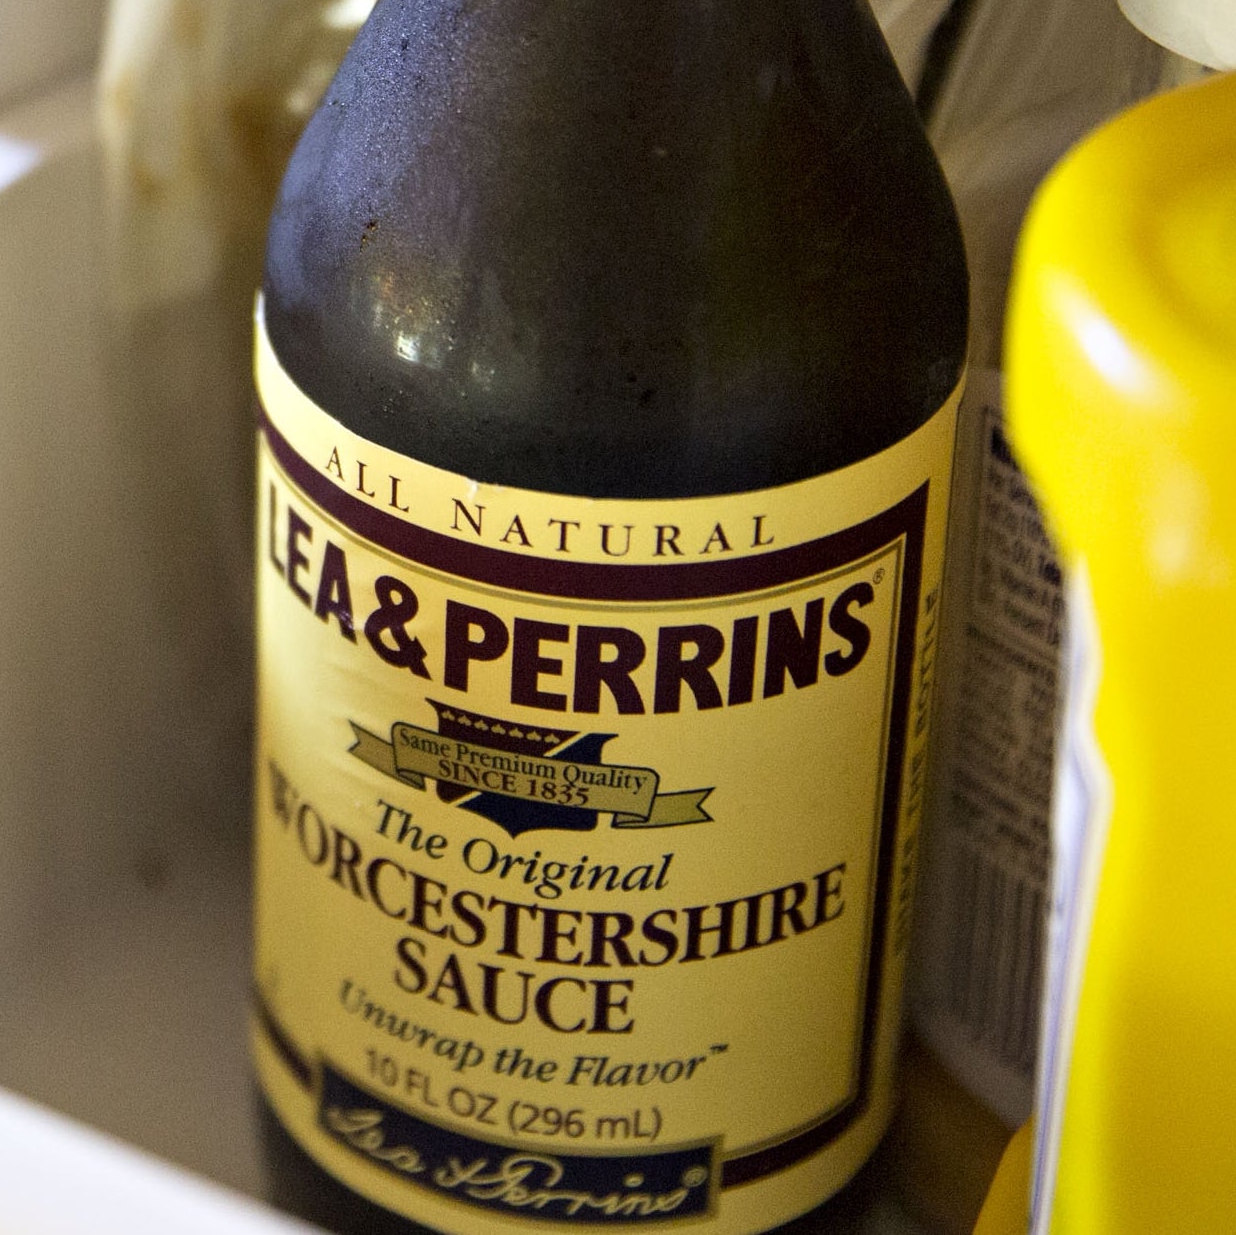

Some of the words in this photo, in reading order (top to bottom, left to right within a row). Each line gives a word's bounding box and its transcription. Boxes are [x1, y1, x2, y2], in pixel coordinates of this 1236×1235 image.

[326, 445, 410, 513] ALL
[450, 497, 775, 556] NATURAL
[399, 729, 451, 758] Same
[456, 739, 556, 781] Premium
[563, 764, 648, 795] Quality
[438, 759, 518, 793] SINCE
[527, 778, 590, 808] 1835
[375, 798, 449, 860] The
[461, 837, 674, 899] Original
[340, 977, 485, 1072] Unwrap
[495, 1048, 559, 1084] the
[393, 938, 636, 1035] SAUCE
[364, 1049, 400, 1088] 10
[405, 1067, 439, 1109] FL
[447, 1087, 499, 1125] OZ
[507, 1100, 585, 1139] (296
[596, 1105, 663, 1141] mL)
